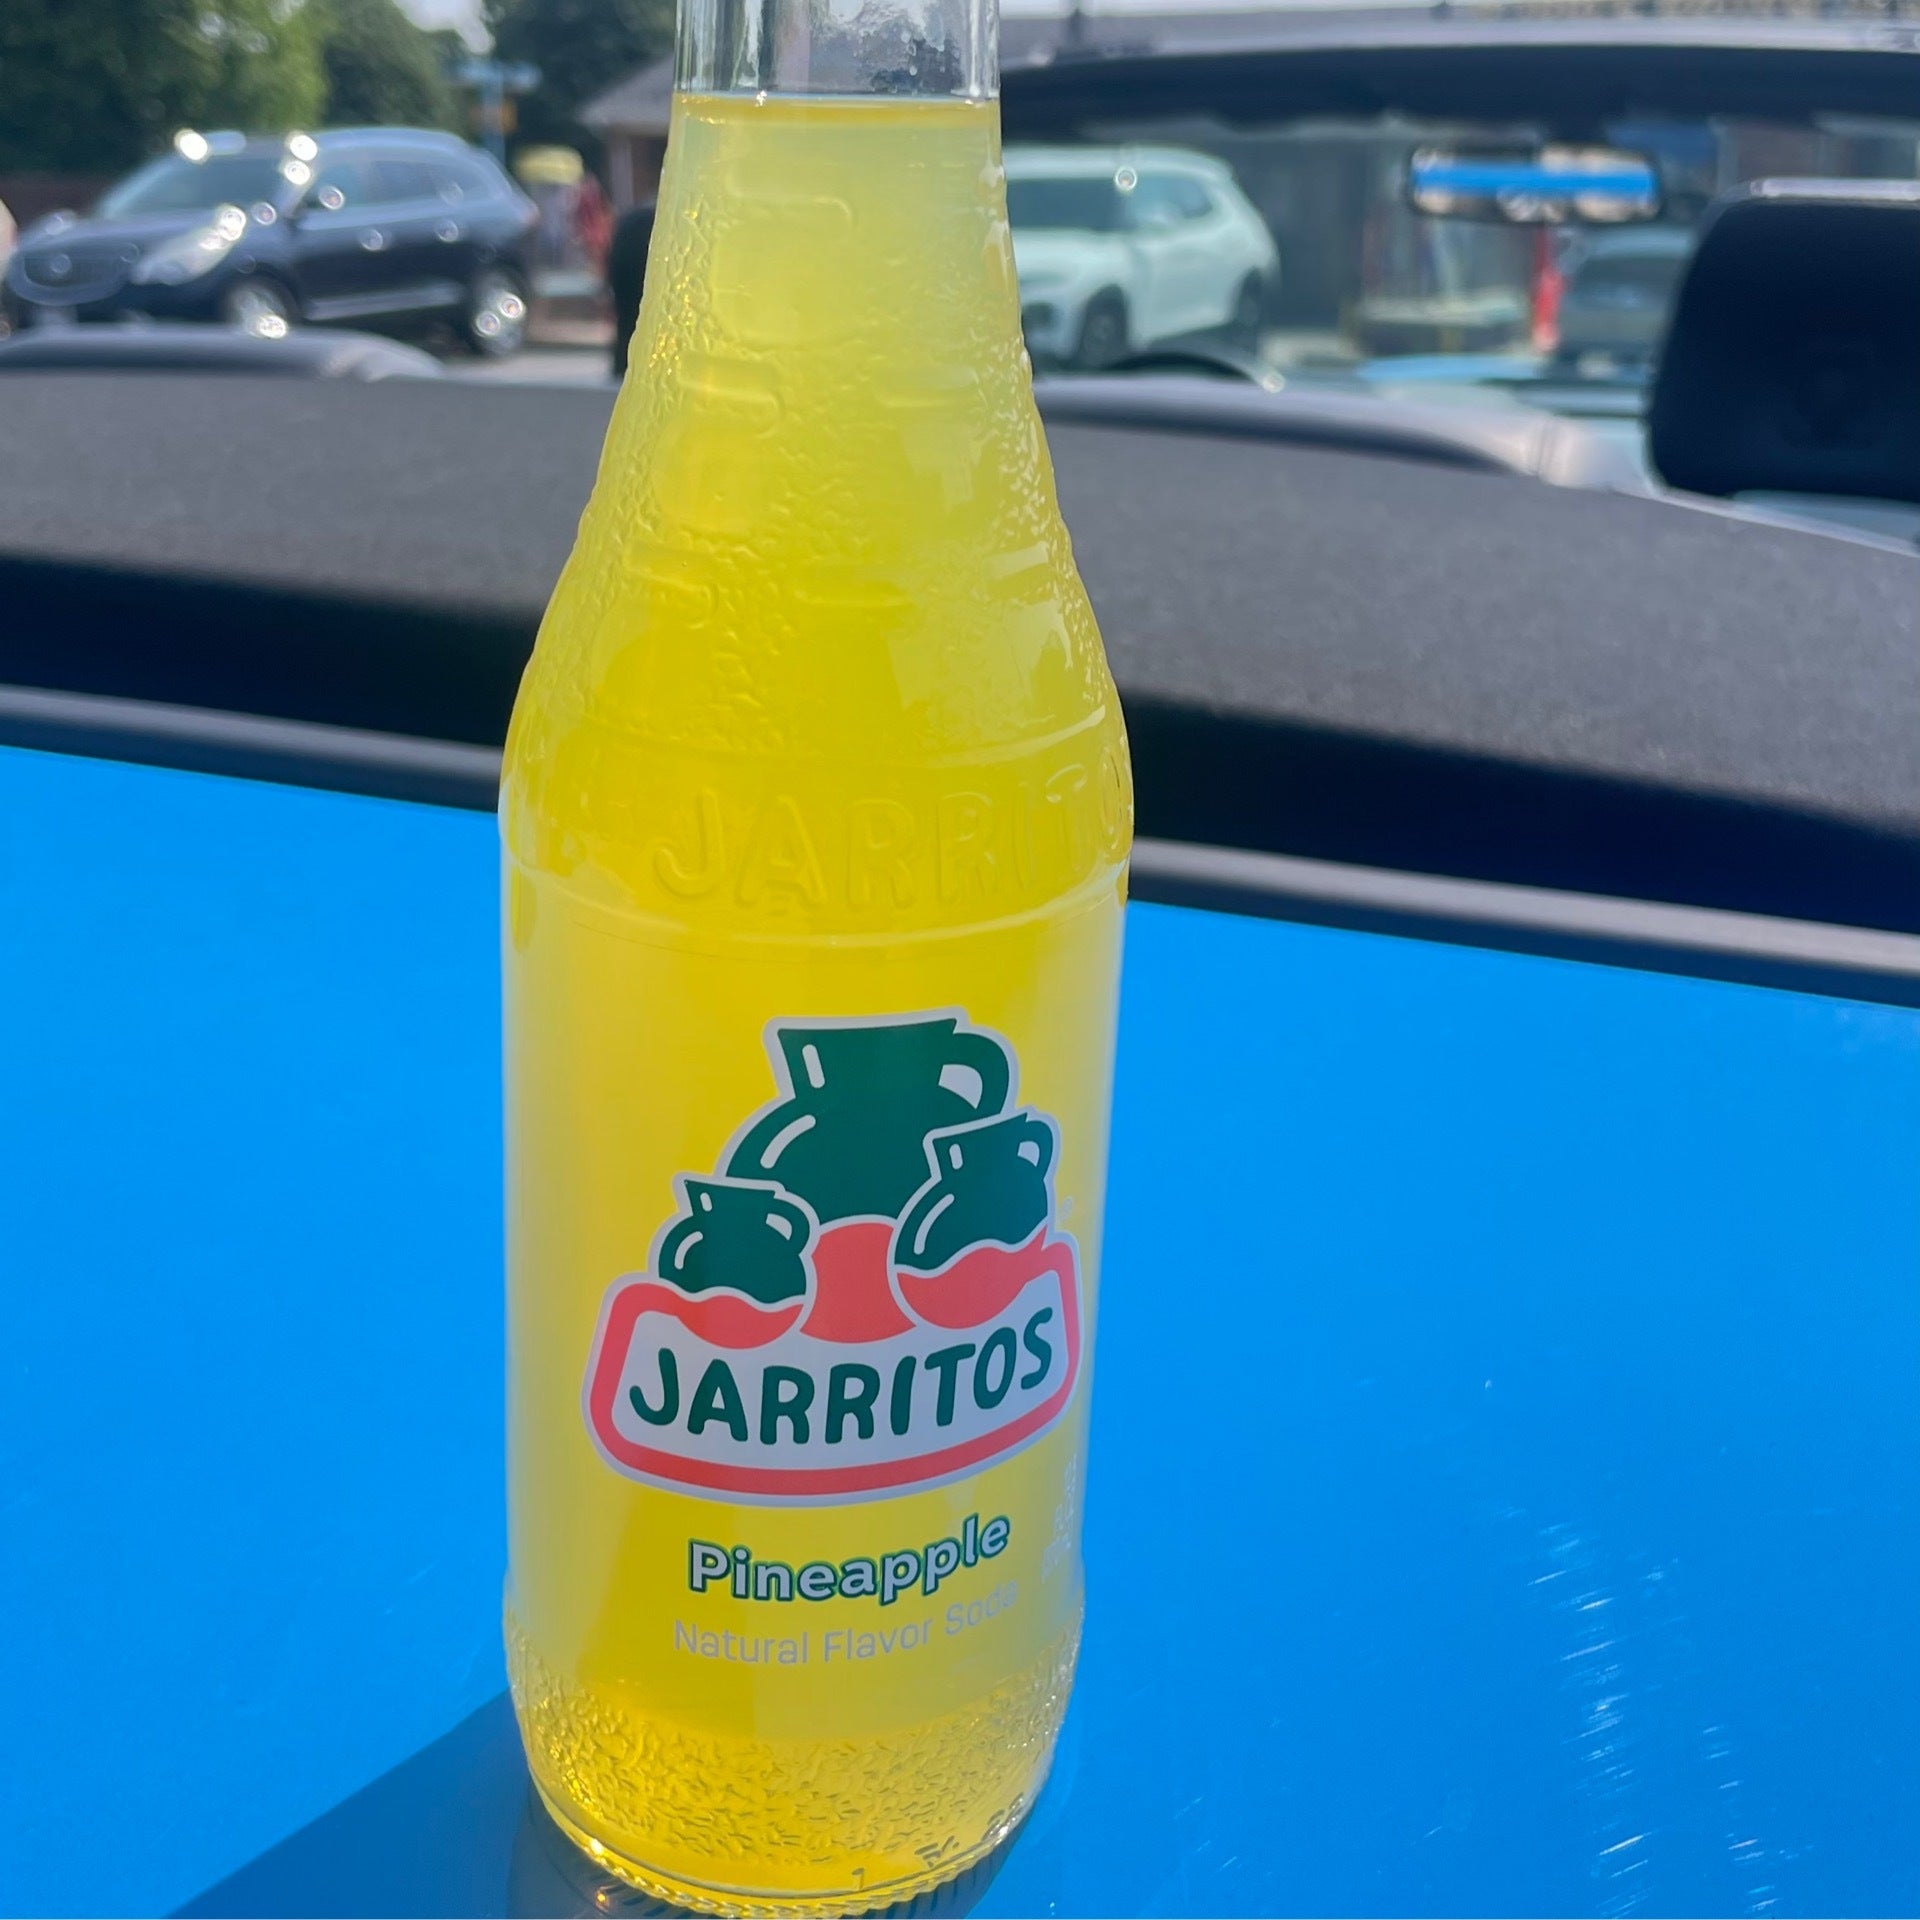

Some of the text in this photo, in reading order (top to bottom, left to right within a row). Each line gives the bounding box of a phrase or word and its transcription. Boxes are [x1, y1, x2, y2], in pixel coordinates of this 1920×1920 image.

[651, 746, 1133, 907] JARRITO
[628, 1306, 1054, 1445] JARRITOS
[687, 1513, 1010, 1606] Pineapple
[673, 1579, 1018, 1666] Natural Flavor Soda
